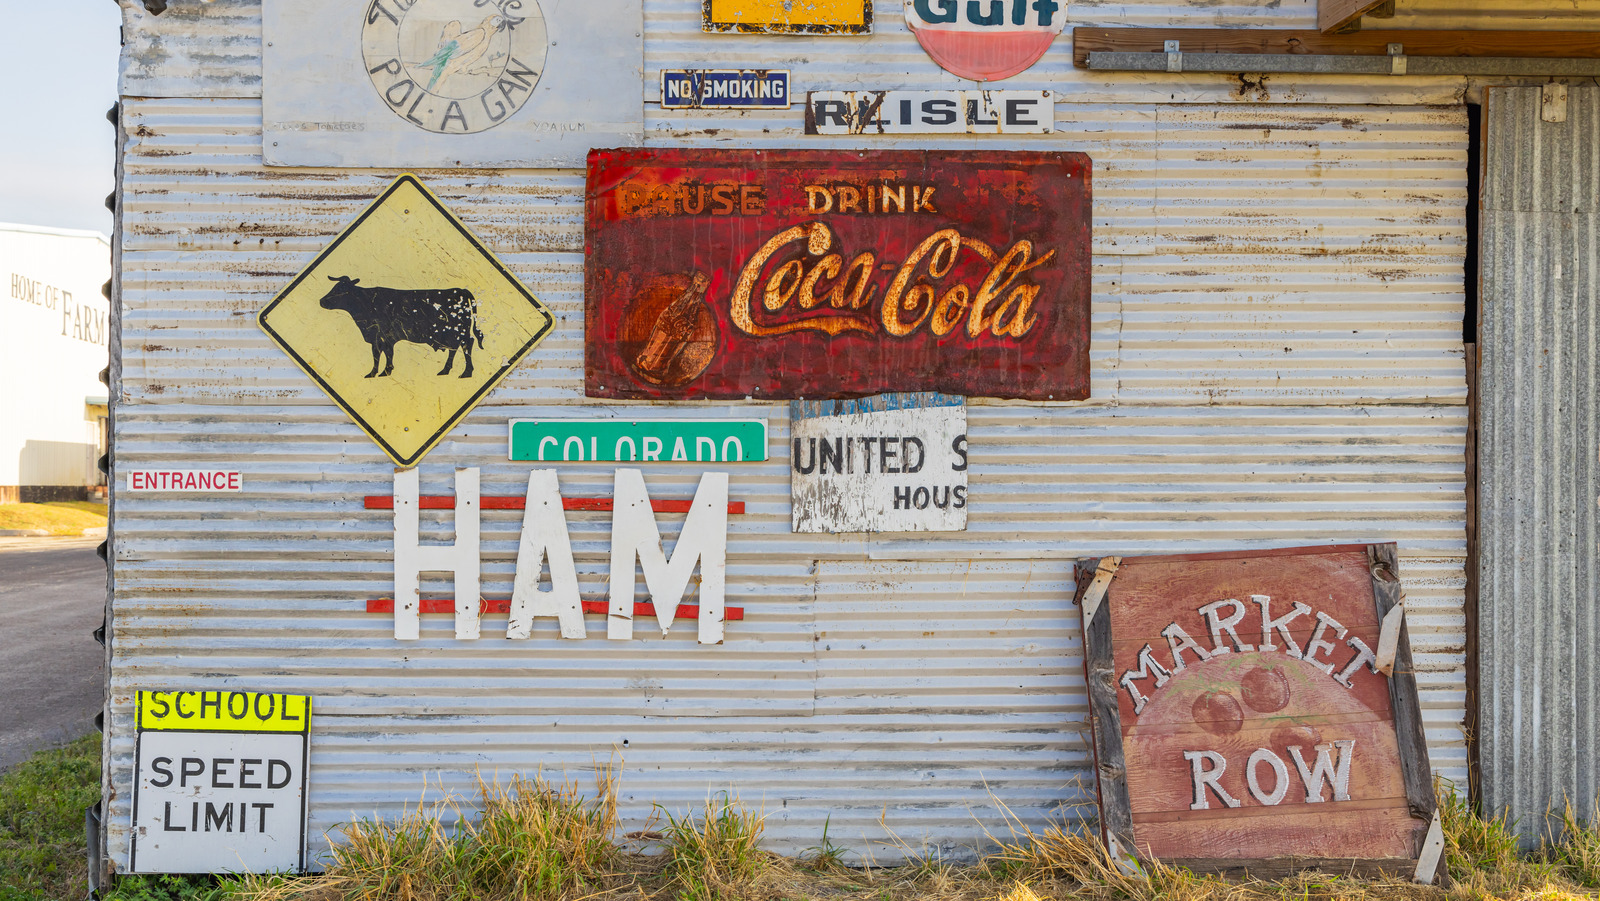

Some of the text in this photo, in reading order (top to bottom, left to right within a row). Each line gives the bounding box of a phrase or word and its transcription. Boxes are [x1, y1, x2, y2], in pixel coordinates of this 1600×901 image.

[668, 80, 784, 99] NO SMOKING
[621, 183, 938, 216] PAUSE DRINK
[11, 272, 42, 306] HOME
[45, 284, 59, 310] OF
[729, 220, 1056, 338] Coca-Cola
[537, 435, 744, 462] COLORADO
[794, 434, 968, 475] UNITED S
[132, 472, 239, 490] ENTRANCE
[893, 485, 967, 510] HOUS
[393, 467, 729, 645] HAM
[1117, 594, 1382, 716] MARKET
[149, 690, 300, 721] SCHOOL
[149, 756, 292, 789] SPEED
[1183, 739, 1356, 811] ROW
[163, 801, 275, 833] LIMIT
